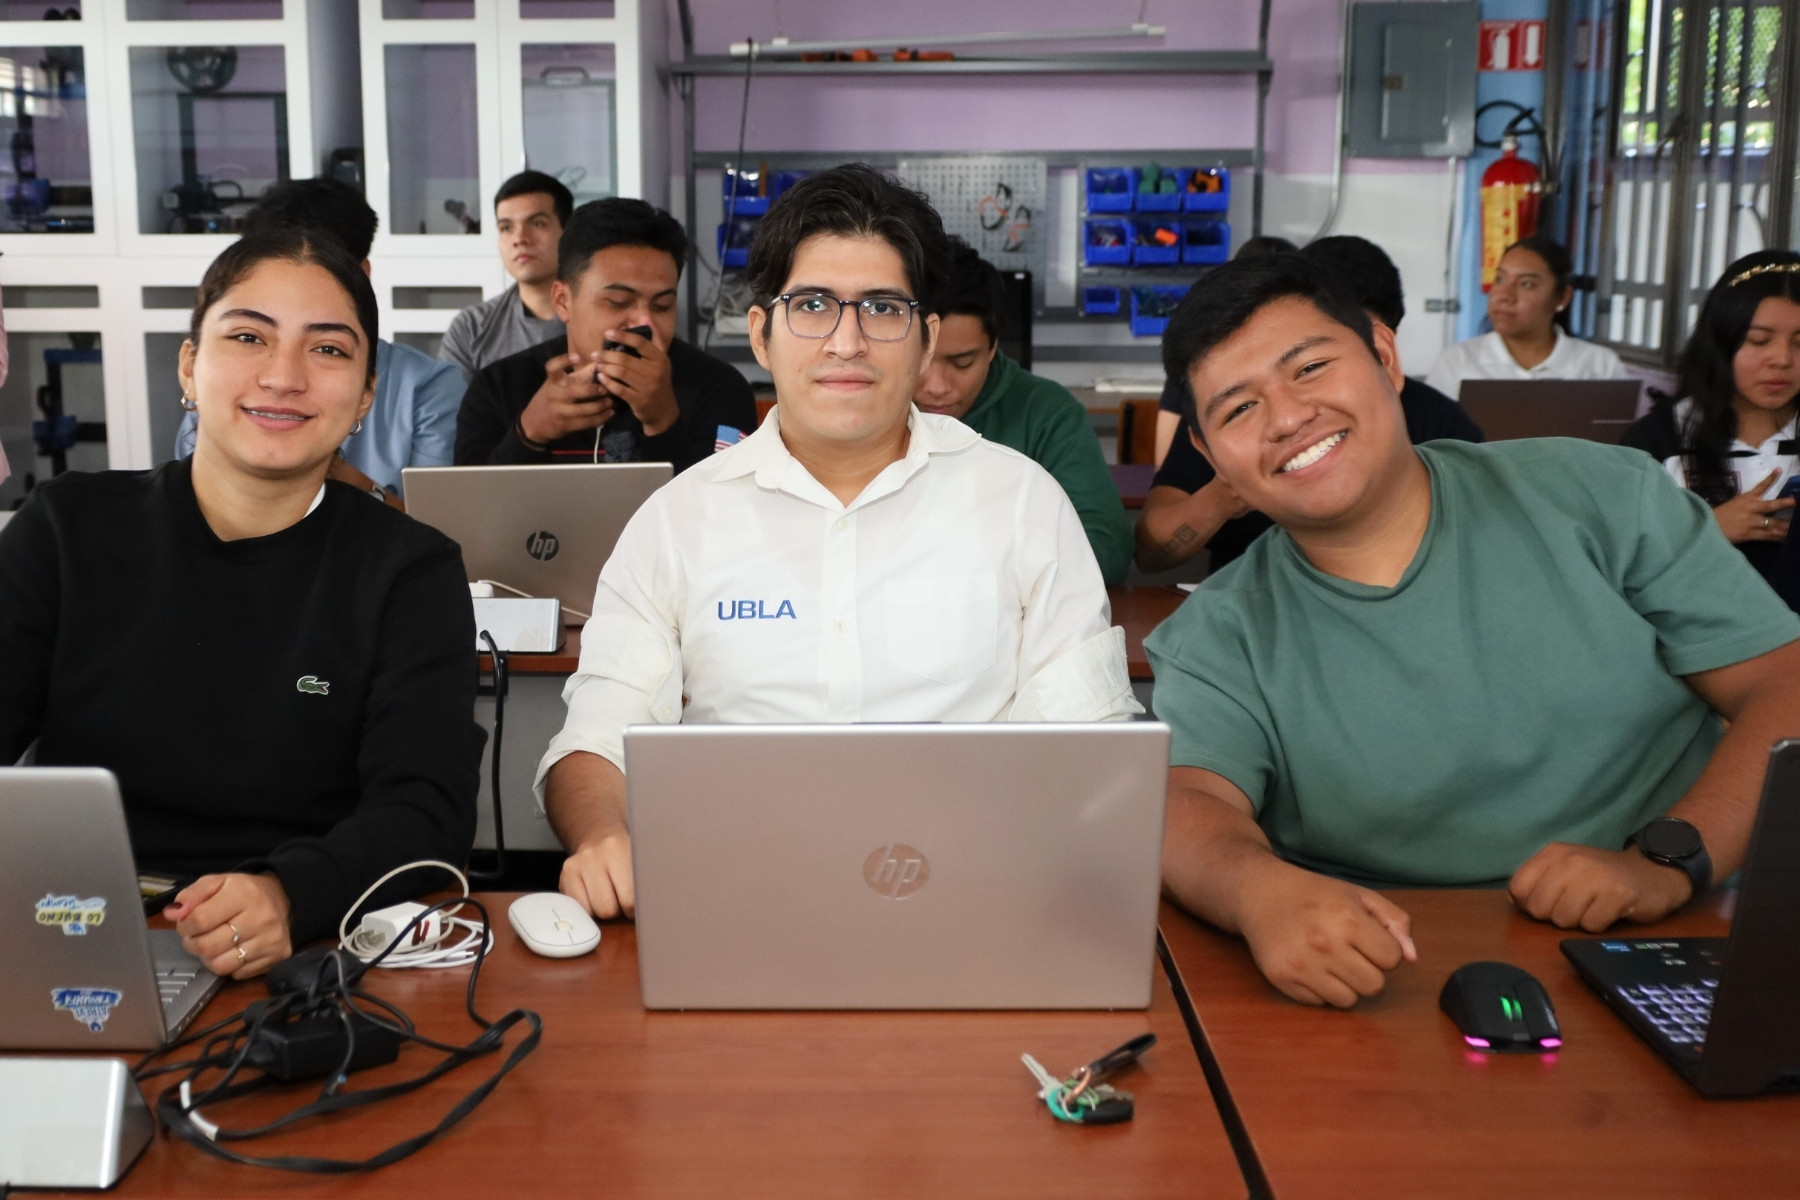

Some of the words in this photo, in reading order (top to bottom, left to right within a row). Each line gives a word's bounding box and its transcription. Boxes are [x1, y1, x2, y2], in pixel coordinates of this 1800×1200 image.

[530, 530, 557, 561] hp
[717, 599, 797, 620] UBLA
[871, 843, 923, 899] hp
